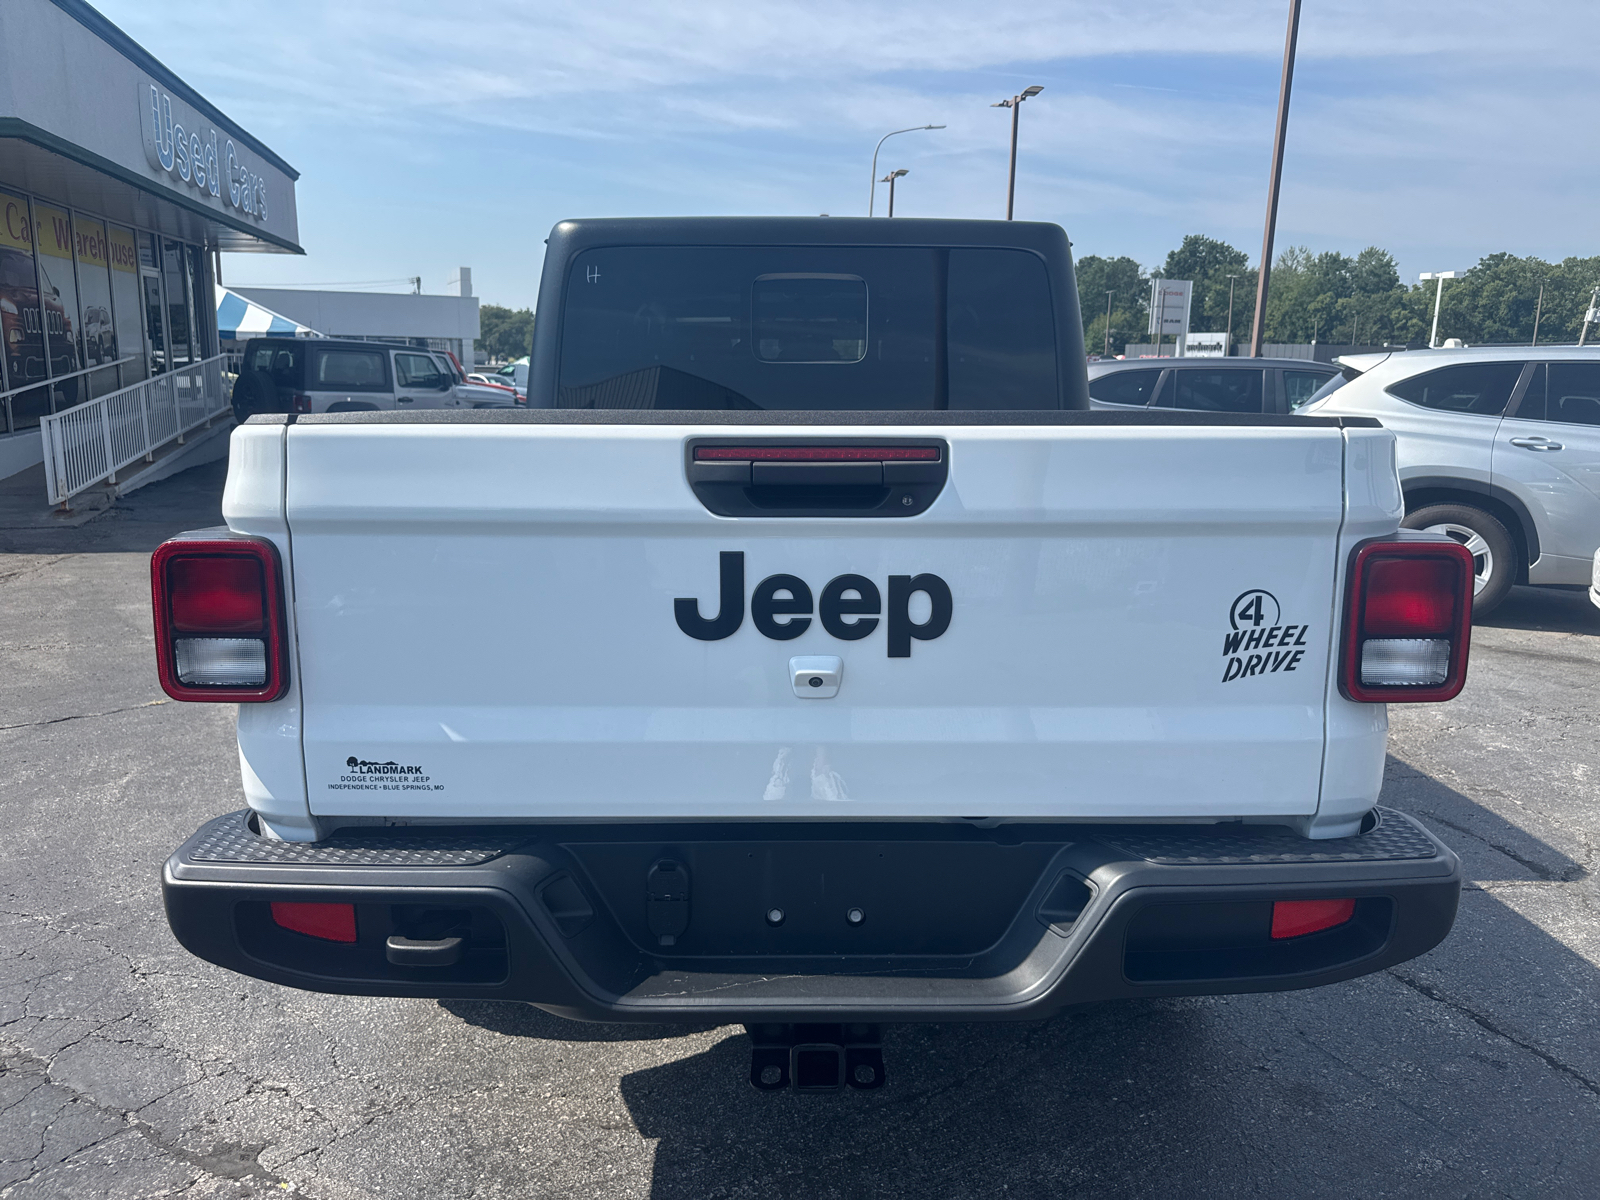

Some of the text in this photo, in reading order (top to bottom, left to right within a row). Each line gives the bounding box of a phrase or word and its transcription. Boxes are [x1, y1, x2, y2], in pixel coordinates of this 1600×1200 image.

[150, 84, 268, 221] Used Cars
[5, 201, 135, 268] Car Warehouse
[673, 551, 953, 658] Jeep
[1238, 595, 1264, 627] 4
[1222, 625, 1309, 657] WHEEL
[1221, 650, 1306, 683] DRIVE
[340, 775, 368, 783] DODGE
[369, 775, 409, 783] CHRYSLER
[359, 765, 423, 774] LANDMARK
[401, 784, 434, 792] SPRINGS,
